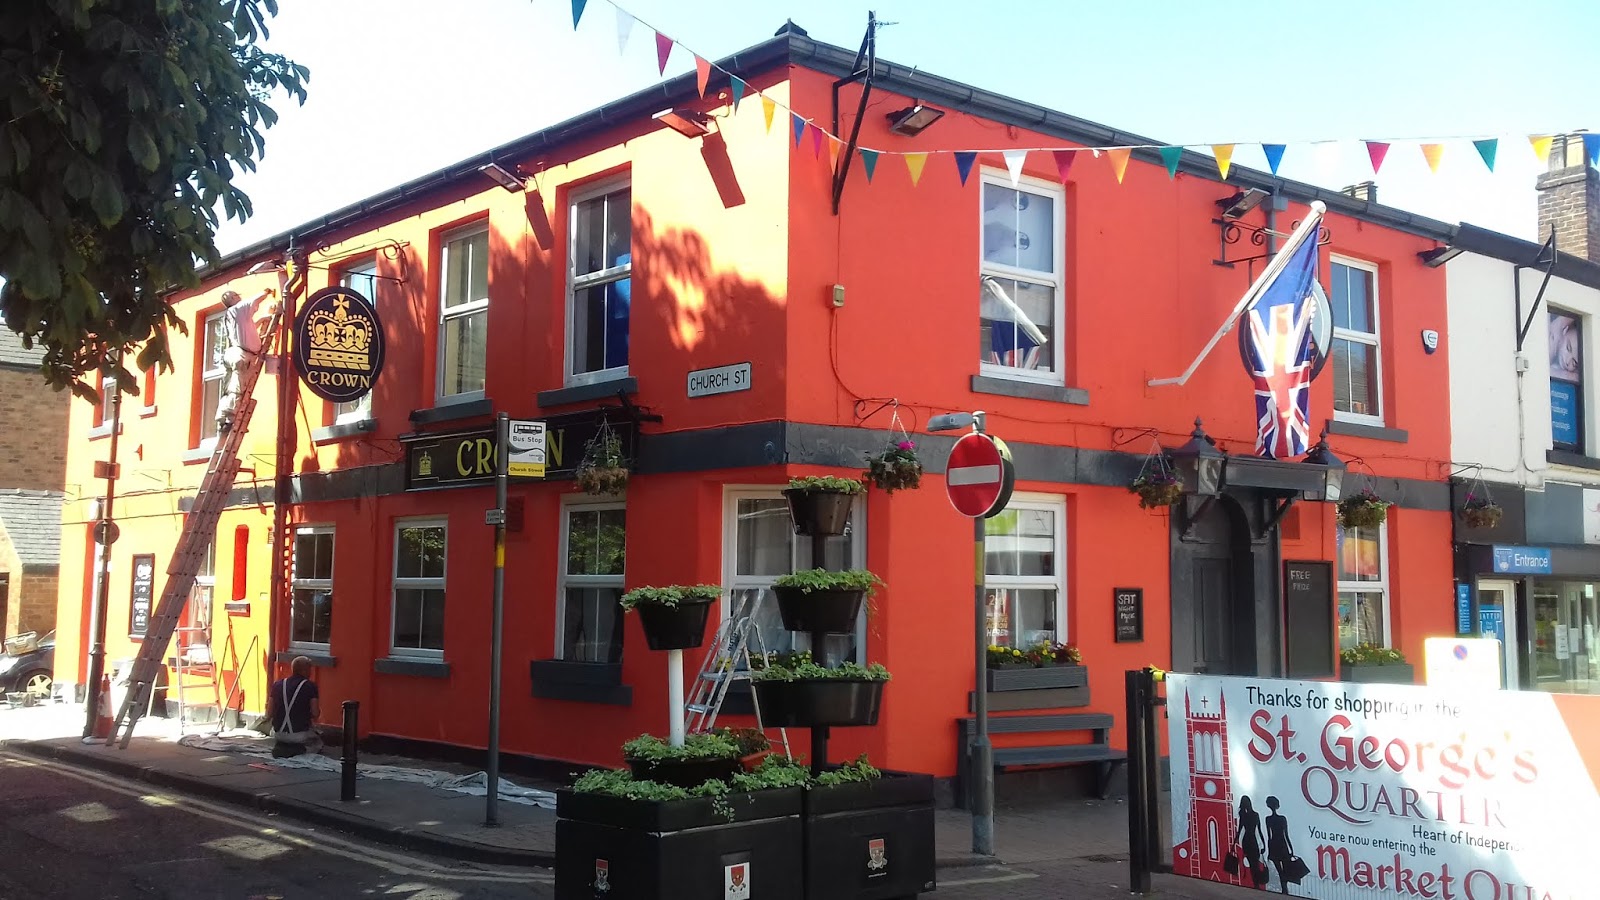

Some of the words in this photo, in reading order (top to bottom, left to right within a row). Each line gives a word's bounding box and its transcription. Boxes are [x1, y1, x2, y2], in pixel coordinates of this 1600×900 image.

[307, 370, 371, 388] CROWN
[690, 372, 729, 391] CHURCH
[734, 369, 747, 384] ST
[527, 436, 543, 444] Stop
[457, 429, 565, 476] CRN
[1514, 553, 1548, 568] Entrance
[1290, 570, 1311, 580] FREE
[1118, 594, 1136, 604] SAT
[1246, 686, 1302, 708] Thanks
[1306, 690, 1329, 710] for
[1334, 692, 1409, 720] shopping
[1435, 699, 1462, 718] the
[1247, 709, 1308, 763] St.
[1320, 714, 1539, 790] George's
[1308, 825, 1327, 840] You
[1329, 832, 1346, 843] are
[1348, 835, 1370, 846] now
[1372, 838, 1416, 857] entering
[1419, 842, 1437, 856] the
[1412, 825, 1447, 841] Heart
[1450, 831, 1463, 844] of
[1316, 844, 1456, 900] Market
